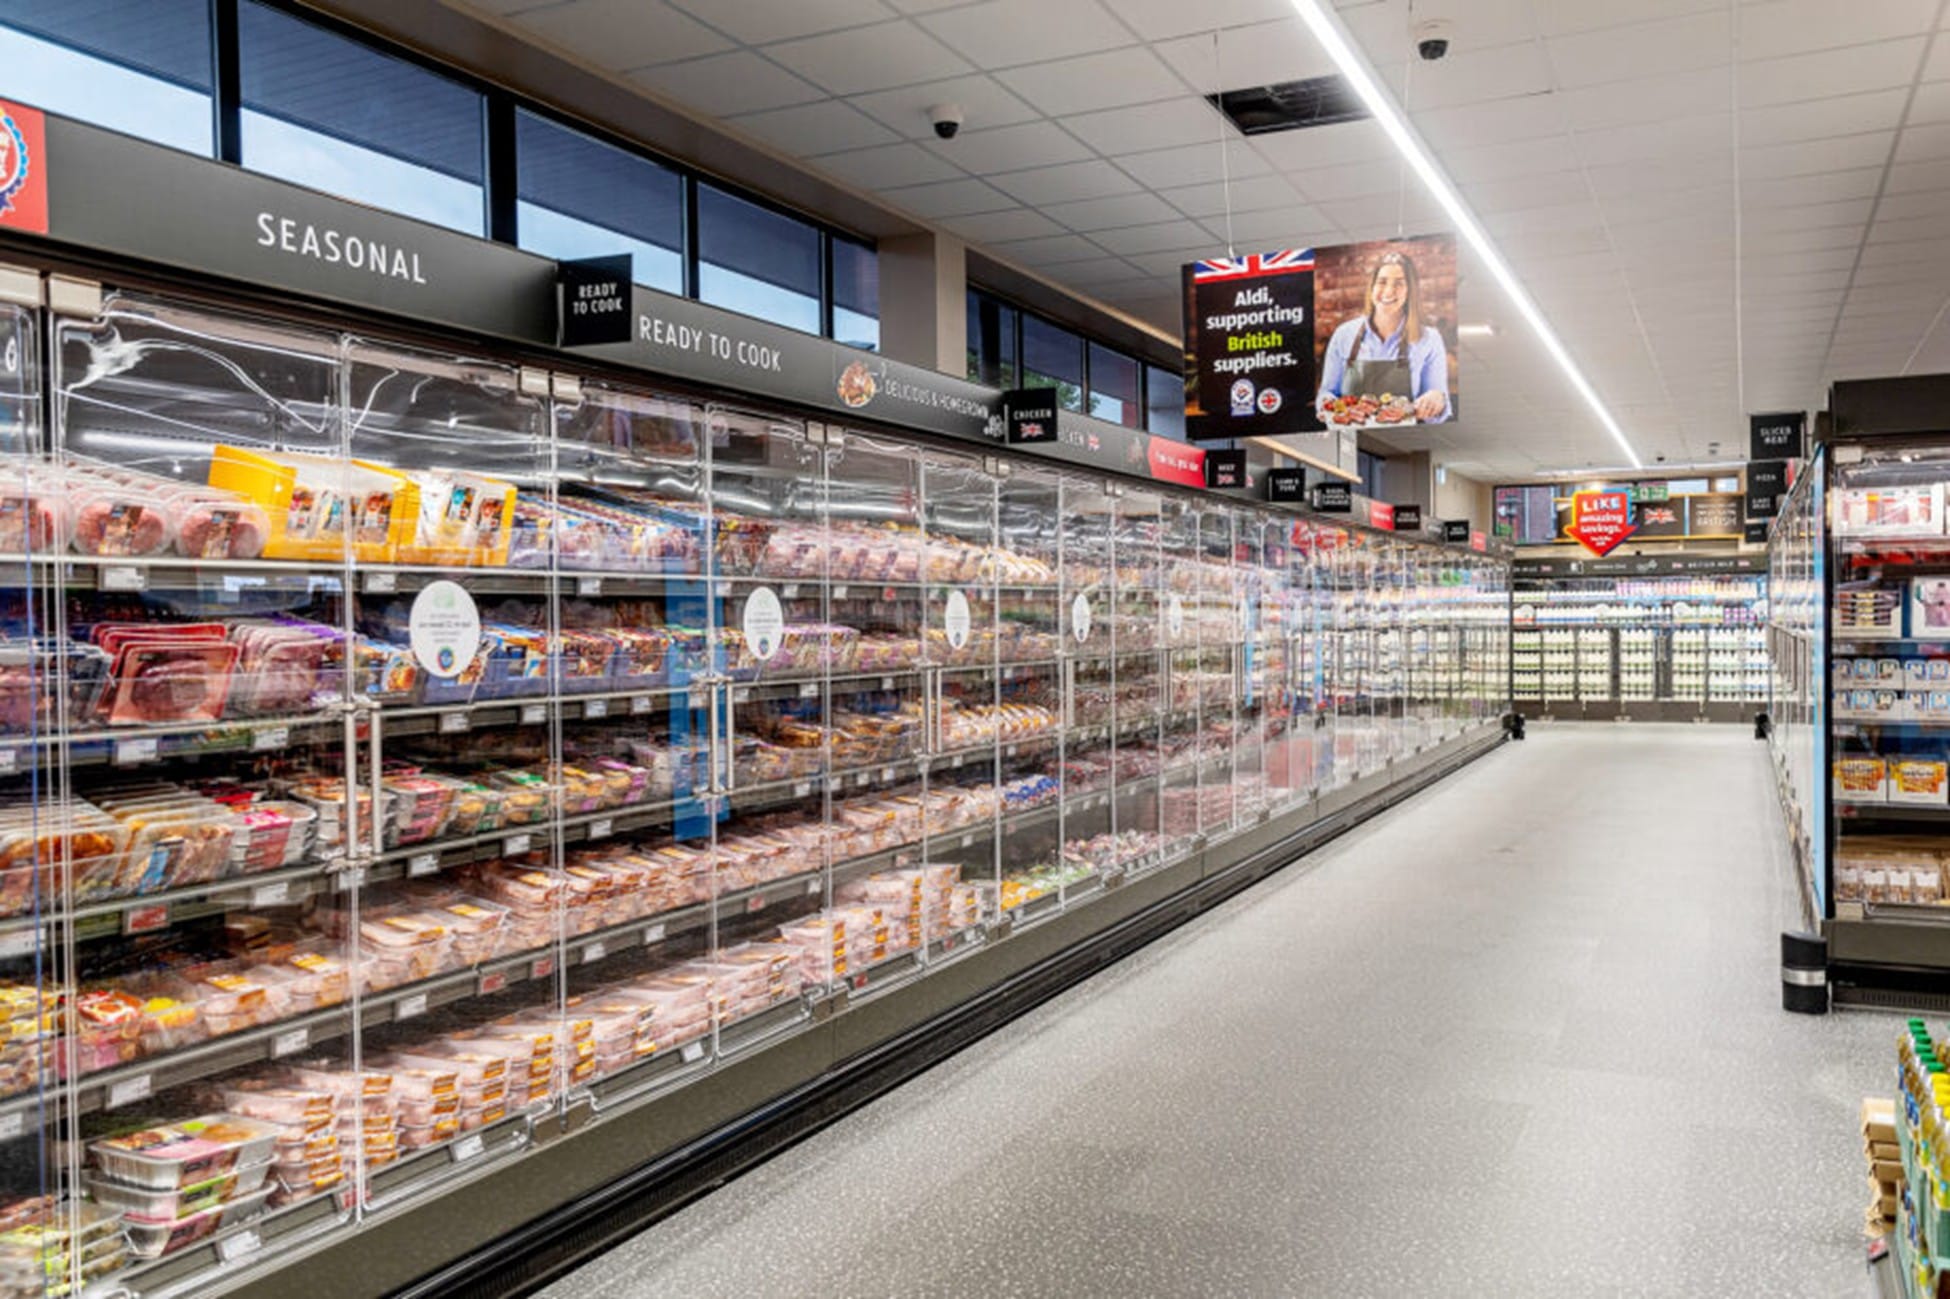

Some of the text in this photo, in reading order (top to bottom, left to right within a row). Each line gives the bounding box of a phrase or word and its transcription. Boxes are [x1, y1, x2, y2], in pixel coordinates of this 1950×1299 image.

[257, 212, 427, 285] SEASONAL
[578, 282, 618, 299] READY
[1234, 285, 1274, 307] Aldi,
[573, 297, 623, 315] TO COOK
[1206, 303, 1304, 331] supporting
[638, 314, 782, 372] READY TO COOK
[1227, 330, 1283, 352] British
[1213, 350, 1298, 375] suppliers.
[884, 378, 930, 406] DELICIOUS
[1012, 408, 1053, 420] CHICKEN
[1759, 426, 1792, 437] SLICED
[1582, 497, 1621, 513] LIKE
[1580, 512, 1624, 524] amazing
